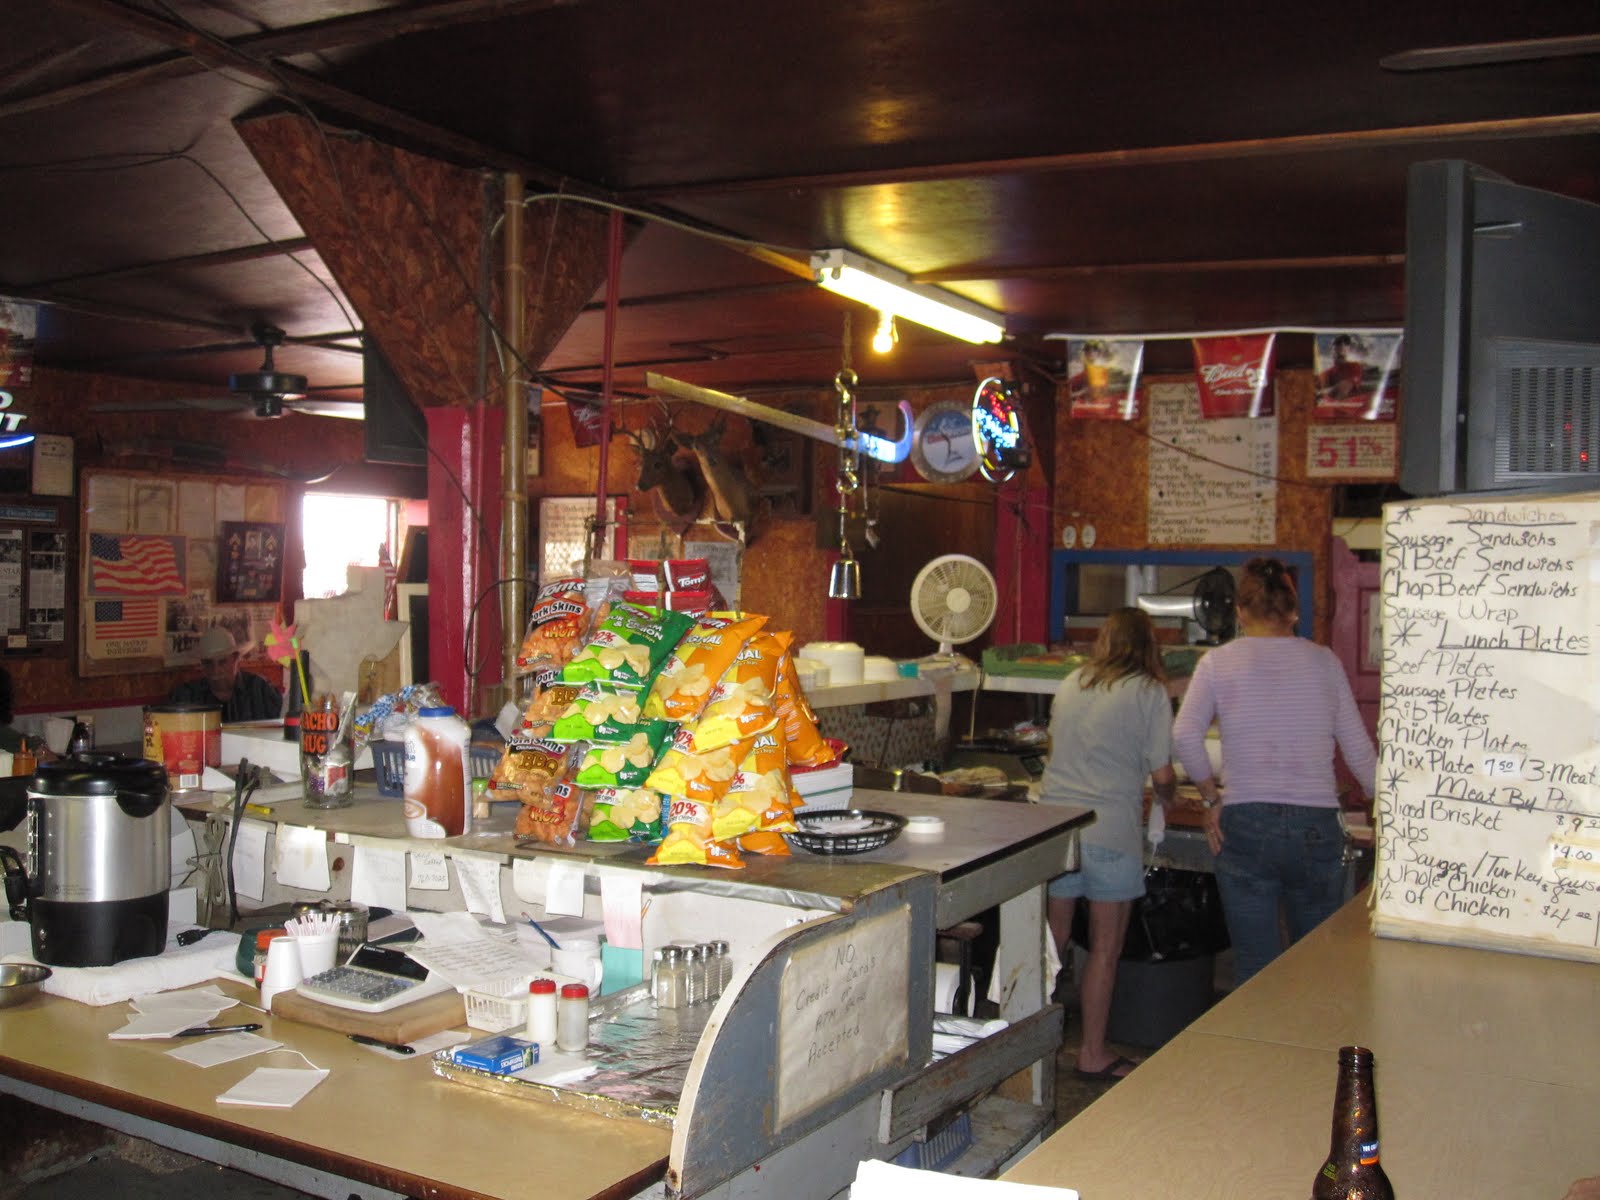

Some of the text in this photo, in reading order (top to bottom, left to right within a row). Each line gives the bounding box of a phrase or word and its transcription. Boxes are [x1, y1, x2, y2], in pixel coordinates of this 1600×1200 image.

[1317, 436, 1383, 468] 51%
[1385, 522, 1454, 552] Sausage
[1414, 546, 1468, 570] Beef
[1382, 569, 1434, 600] Chop
[1425, 572, 1490, 597] Beef
[550, 601, 584, 615] Skins
[1384, 596, 1519, 627] Sausage Wrap
[1437, 620, 1590, 651] Lunch Plates
[1382, 649, 1495, 678] Beef Plates
[1382, 675, 1518, 700] Sausage Plates
[1382, 696, 1490, 726] Rib Plates
[1379, 717, 1454, 750] Chicken
[518, 752, 559, 777] BBQ
[1380, 743, 1424, 772] Mix
[1425, 749, 1475, 775] Plate
[1434, 774, 1497, 804] Meat
[1502, 787, 1537, 813] By
[1380, 812, 1429, 843] Ribs
[1430, 801, 1503, 832] Brisket
[1380, 865, 1441, 888] Whole
[1448, 873, 1516, 899] Chicken
[1434, 889, 1511, 919] Chicken
[834, 943, 856, 971] NO
[795, 981, 830, 1011] Credit
[815, 1009, 837, 1033] ATM
[807, 1022, 860, 1069] Accepted
